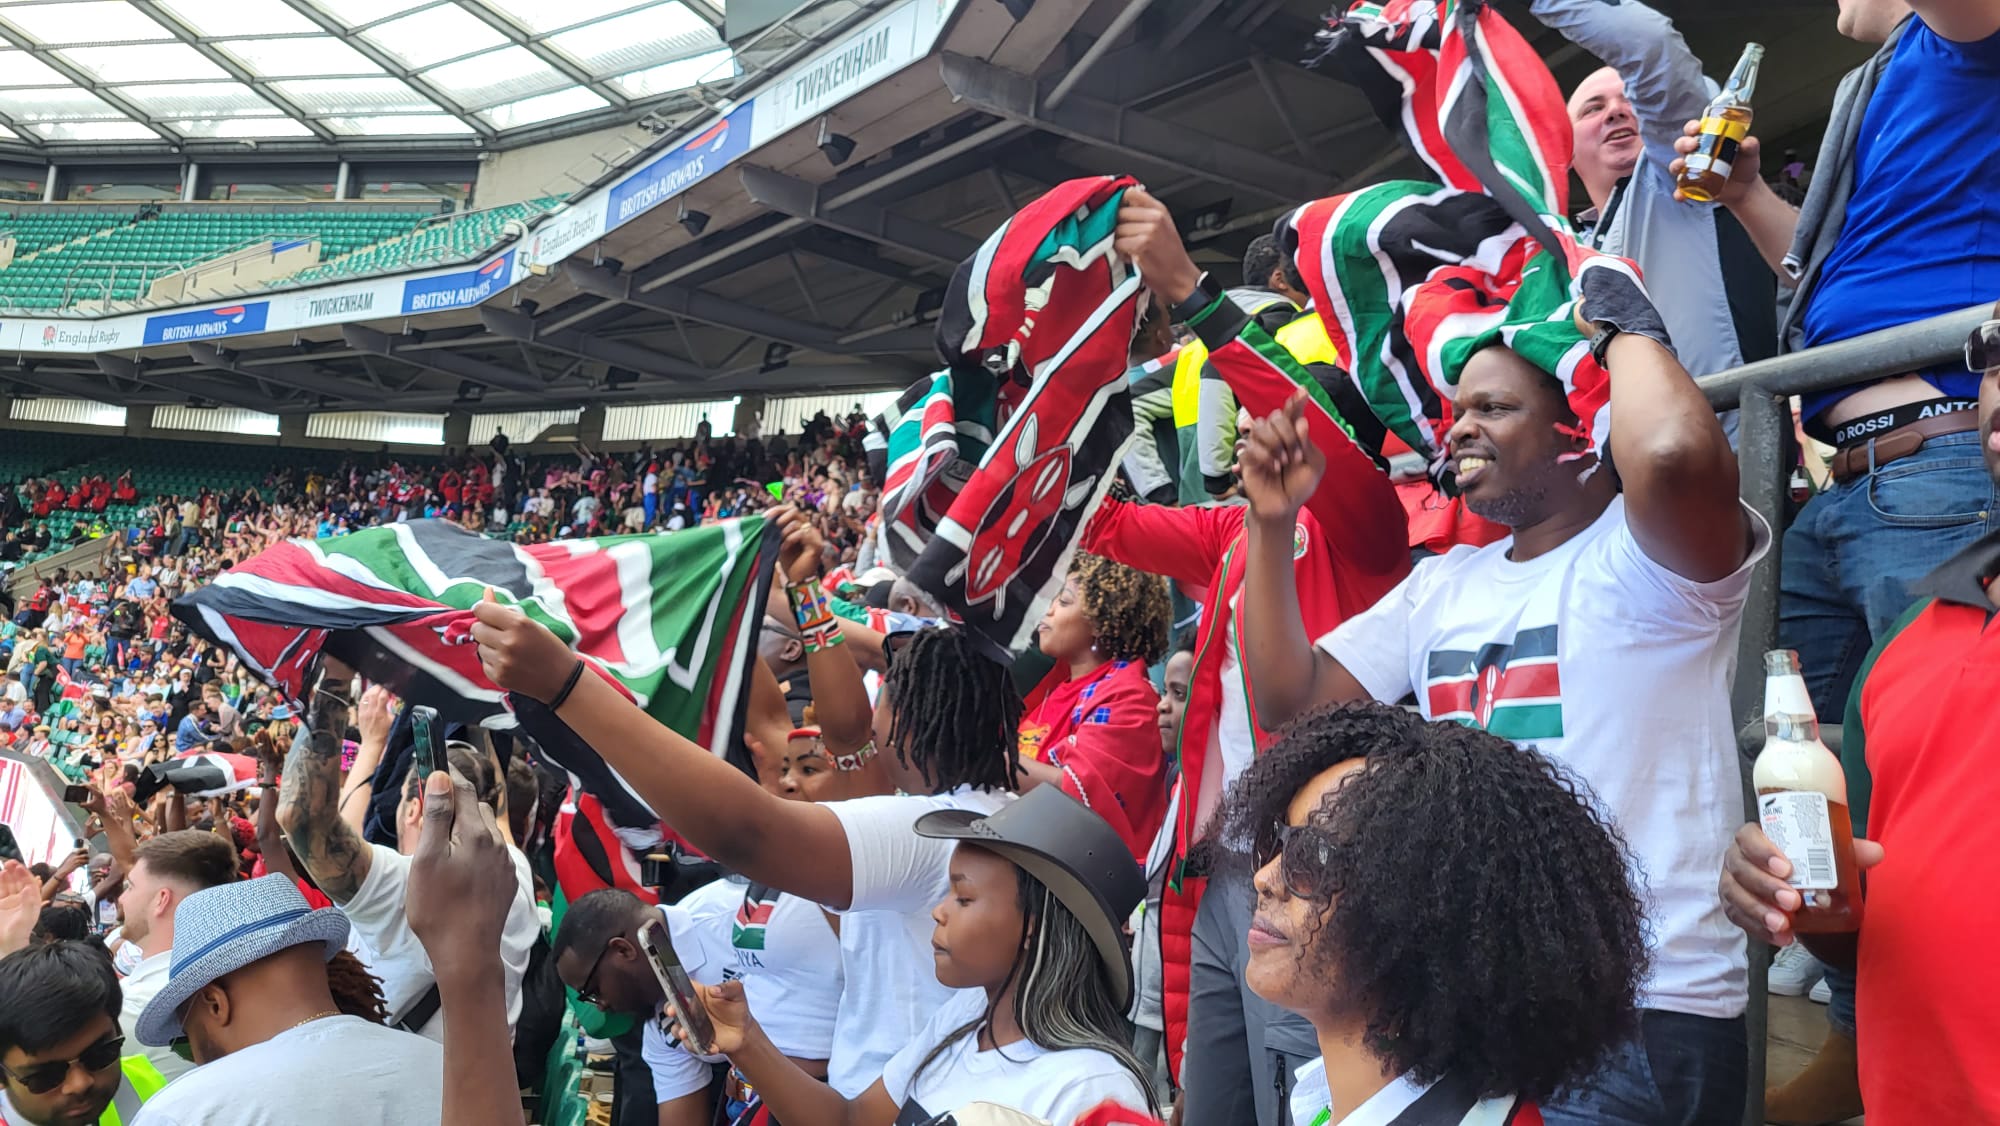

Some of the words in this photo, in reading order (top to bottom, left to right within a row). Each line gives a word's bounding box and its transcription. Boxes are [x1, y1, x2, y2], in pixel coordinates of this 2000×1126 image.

[795, 26, 890, 109] TWIKENHAM
[619, 181, 659, 220] BRITISH
[660, 155, 704, 195] AIRWAYS
[309, 292, 374, 318] TWICKENHAM
[412, 289, 456, 310] BRITISH
[58, 330, 99, 346] England
[99, 327, 120, 345] Rugby
[162, 325, 194, 341] BRITISH
[193, 320, 228, 337] AIRWAYS
[1847, 413, 1894, 439] ROSSI
[735, 950, 765, 968] NYA
